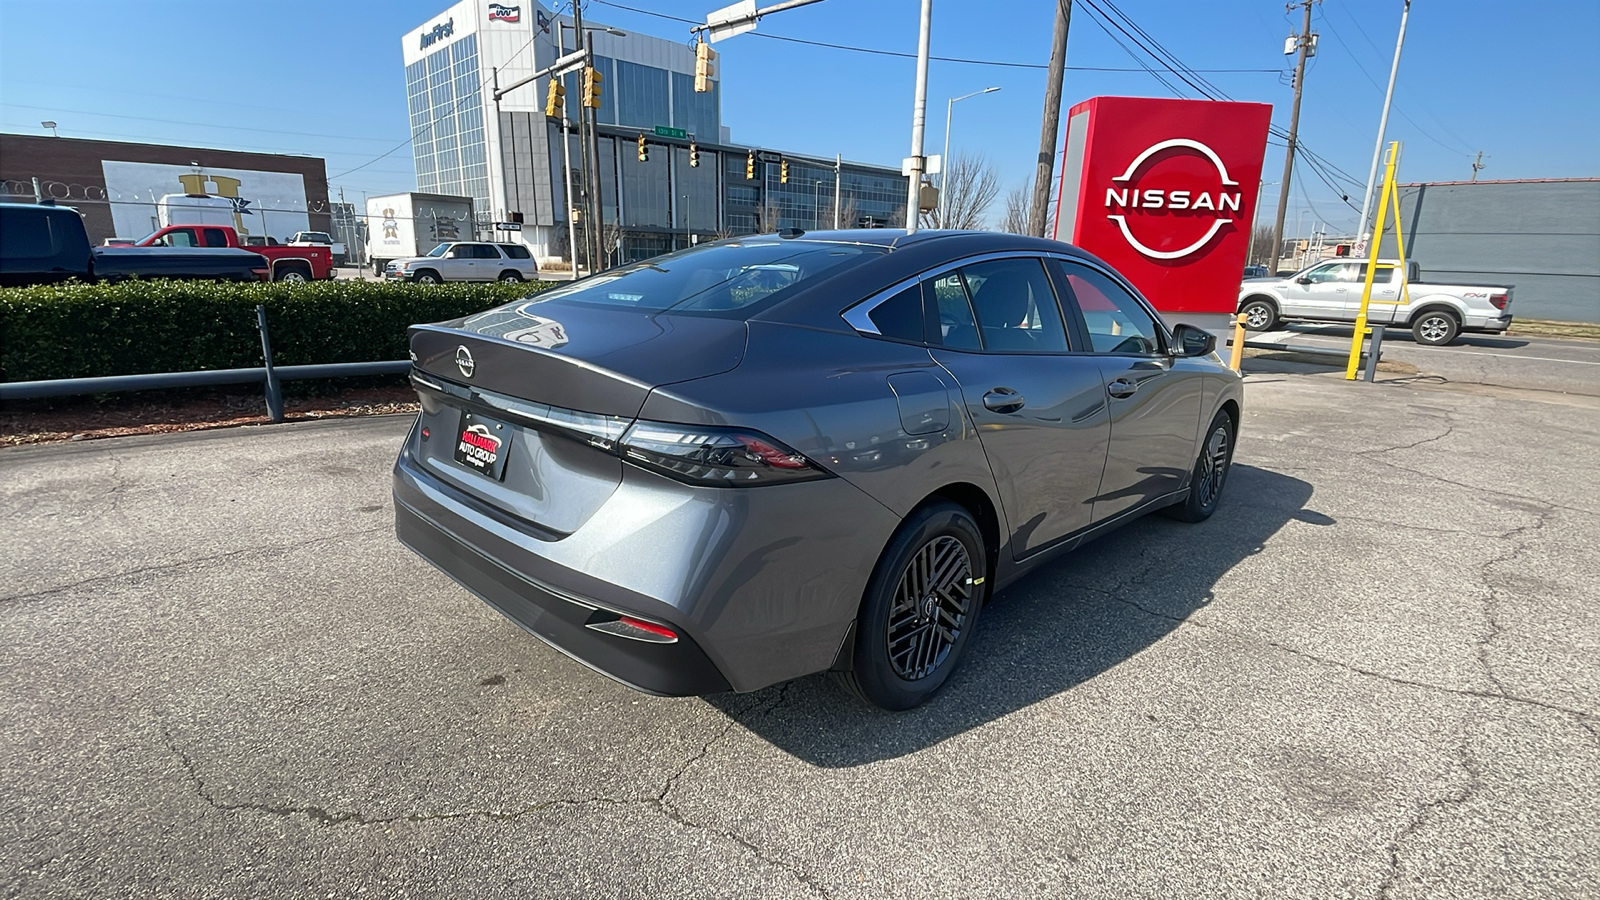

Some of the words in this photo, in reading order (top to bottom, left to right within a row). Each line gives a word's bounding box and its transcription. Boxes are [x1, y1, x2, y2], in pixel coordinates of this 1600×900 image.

[1104, 188, 1242, 212] NISSAN
[459, 441, 475, 456] AUTO
[474, 447, 497, 464] GROUP
[462, 430, 498, 453] HALLMARK
